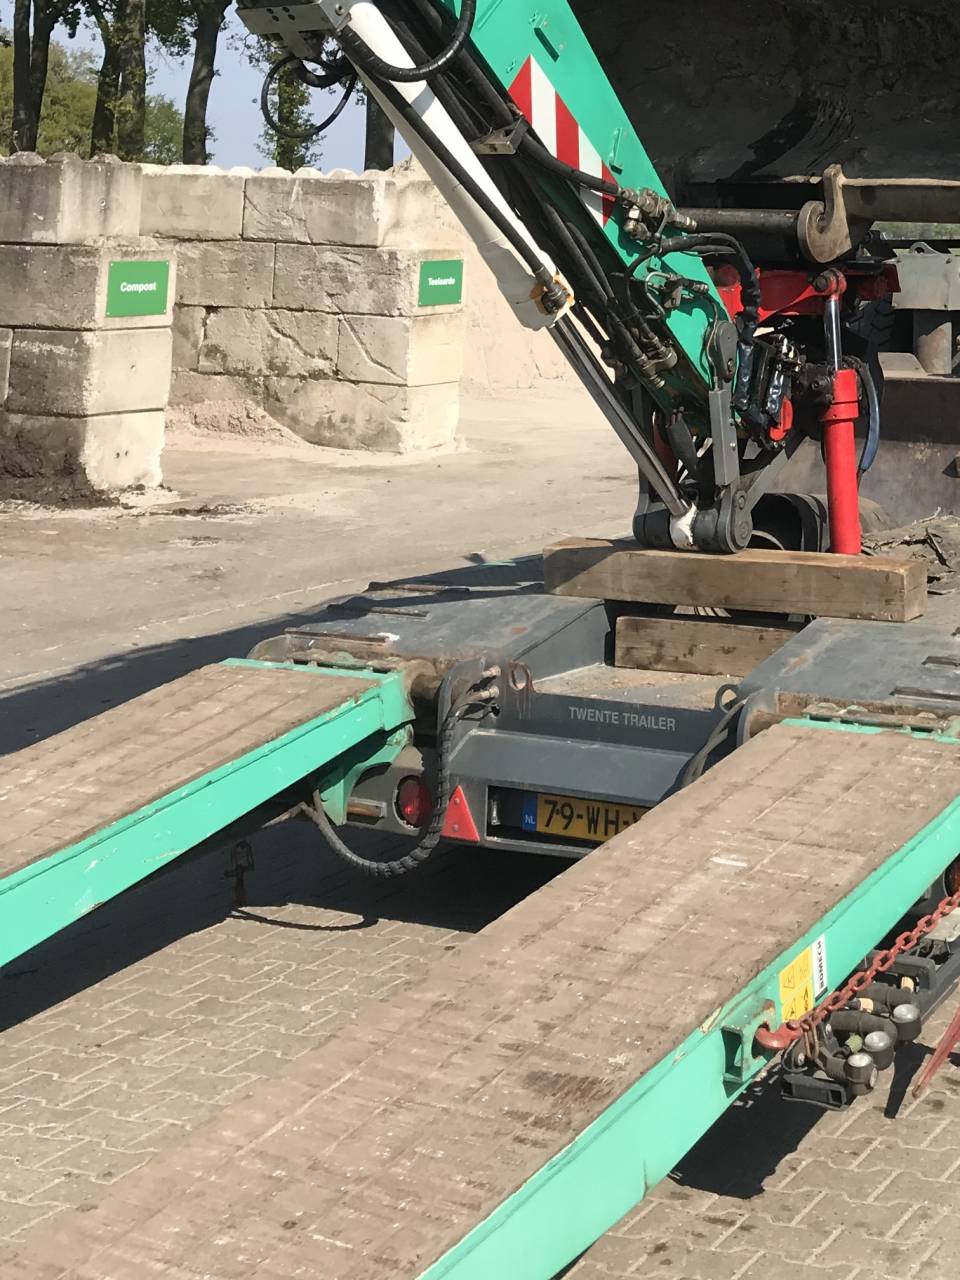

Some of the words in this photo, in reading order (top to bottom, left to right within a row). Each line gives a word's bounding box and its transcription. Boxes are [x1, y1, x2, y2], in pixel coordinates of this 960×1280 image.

[120, 281, 157, 294] Compost
[568, 706, 619, 725] TWENTE
[622, 712, 676, 732] TRAILER
[524, 814, 536, 825] NL
